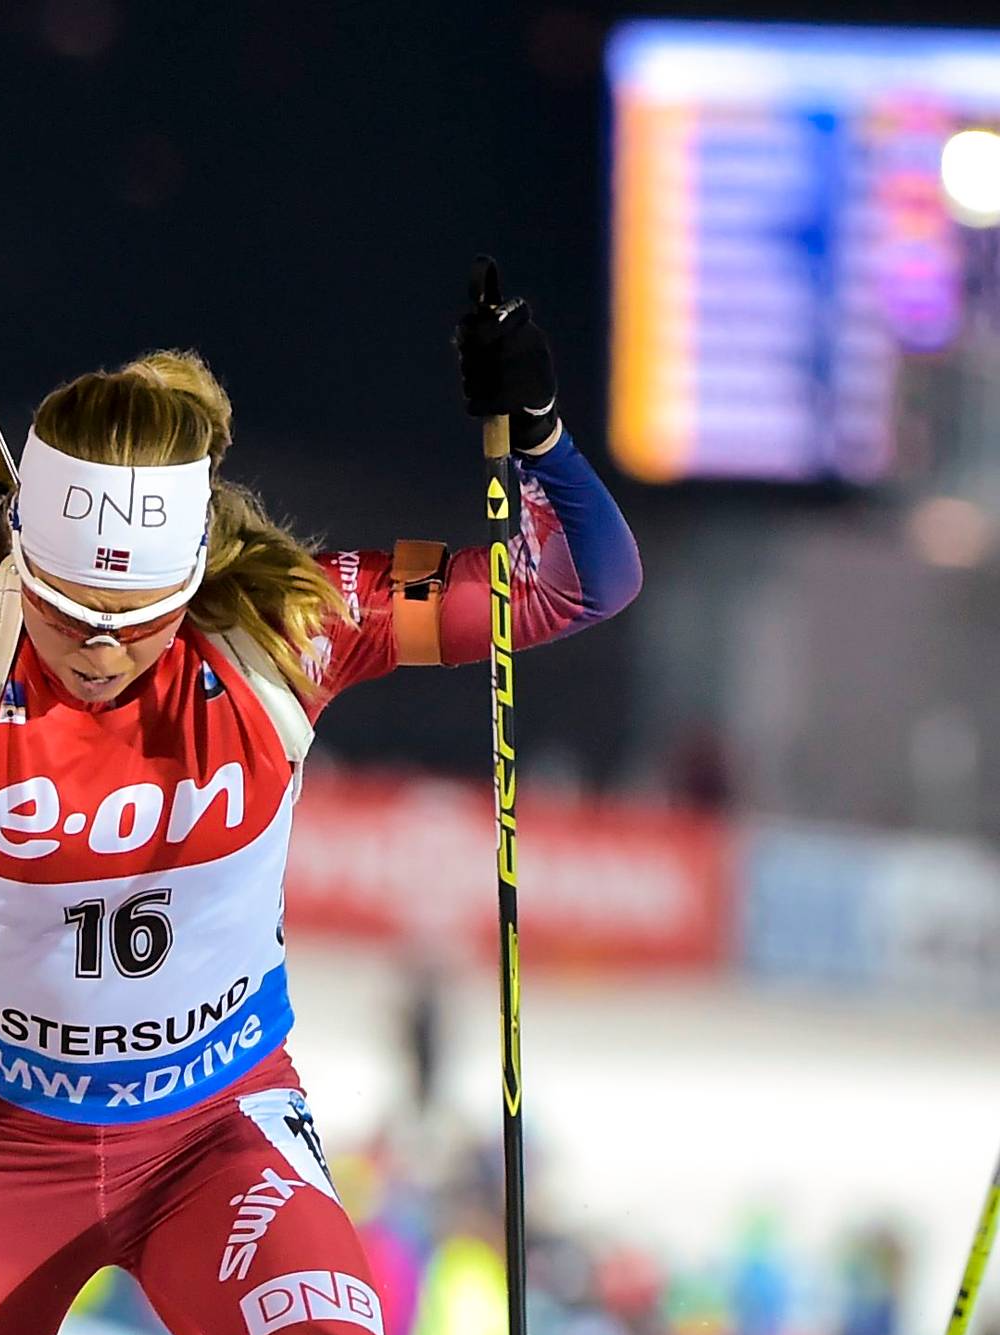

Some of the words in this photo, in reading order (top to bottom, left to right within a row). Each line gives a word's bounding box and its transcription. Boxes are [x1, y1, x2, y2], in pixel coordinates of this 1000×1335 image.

[63, 468, 167, 535] DNB
[64, 888, 173, 979] 16
[106, 1013, 262, 1107] xDrive
[218, 1167, 307, 1281] swix
[258, 1272, 374, 1323] DNB
